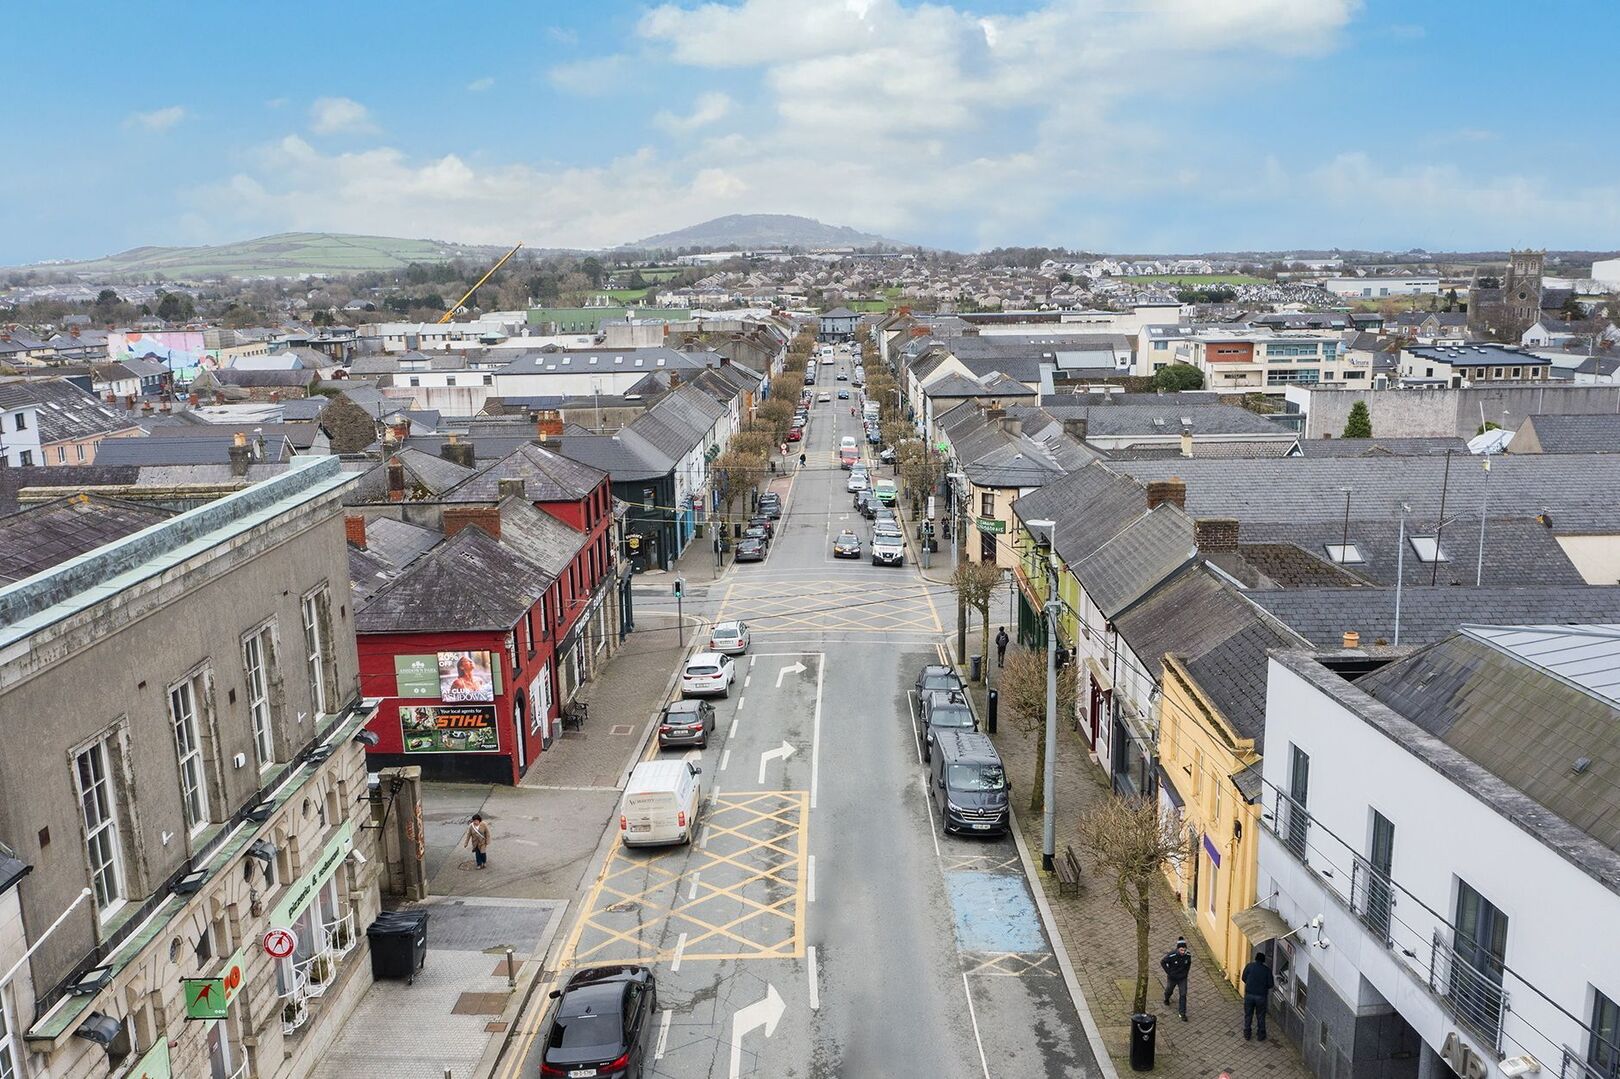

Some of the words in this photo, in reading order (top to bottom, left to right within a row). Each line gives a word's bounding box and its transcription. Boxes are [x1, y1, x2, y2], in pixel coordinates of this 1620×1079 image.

[436, 715, 487, 727] STIHL
[288, 885, 311, 919] pizzeria
[312, 873, 318, 886] &
